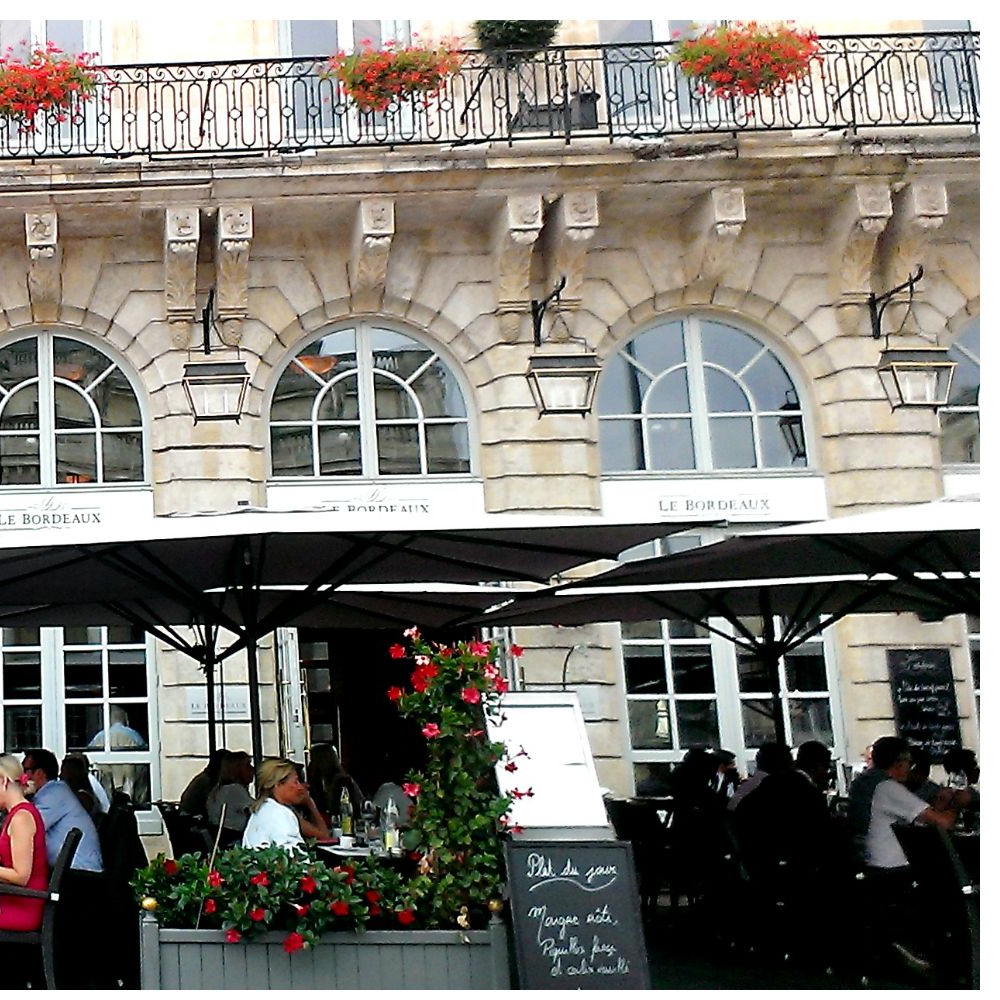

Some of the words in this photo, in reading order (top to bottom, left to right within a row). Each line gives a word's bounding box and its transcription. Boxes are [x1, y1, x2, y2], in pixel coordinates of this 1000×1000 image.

[658, 500, 678, 511] LE
[685, 499, 771, 511] BORDEAUX
[22, 513, 101, 525] BORDEAUX
[527, 852, 556, 878] Plat
[560, 858, 580, 876] du
[585, 863, 618, 884] jour
